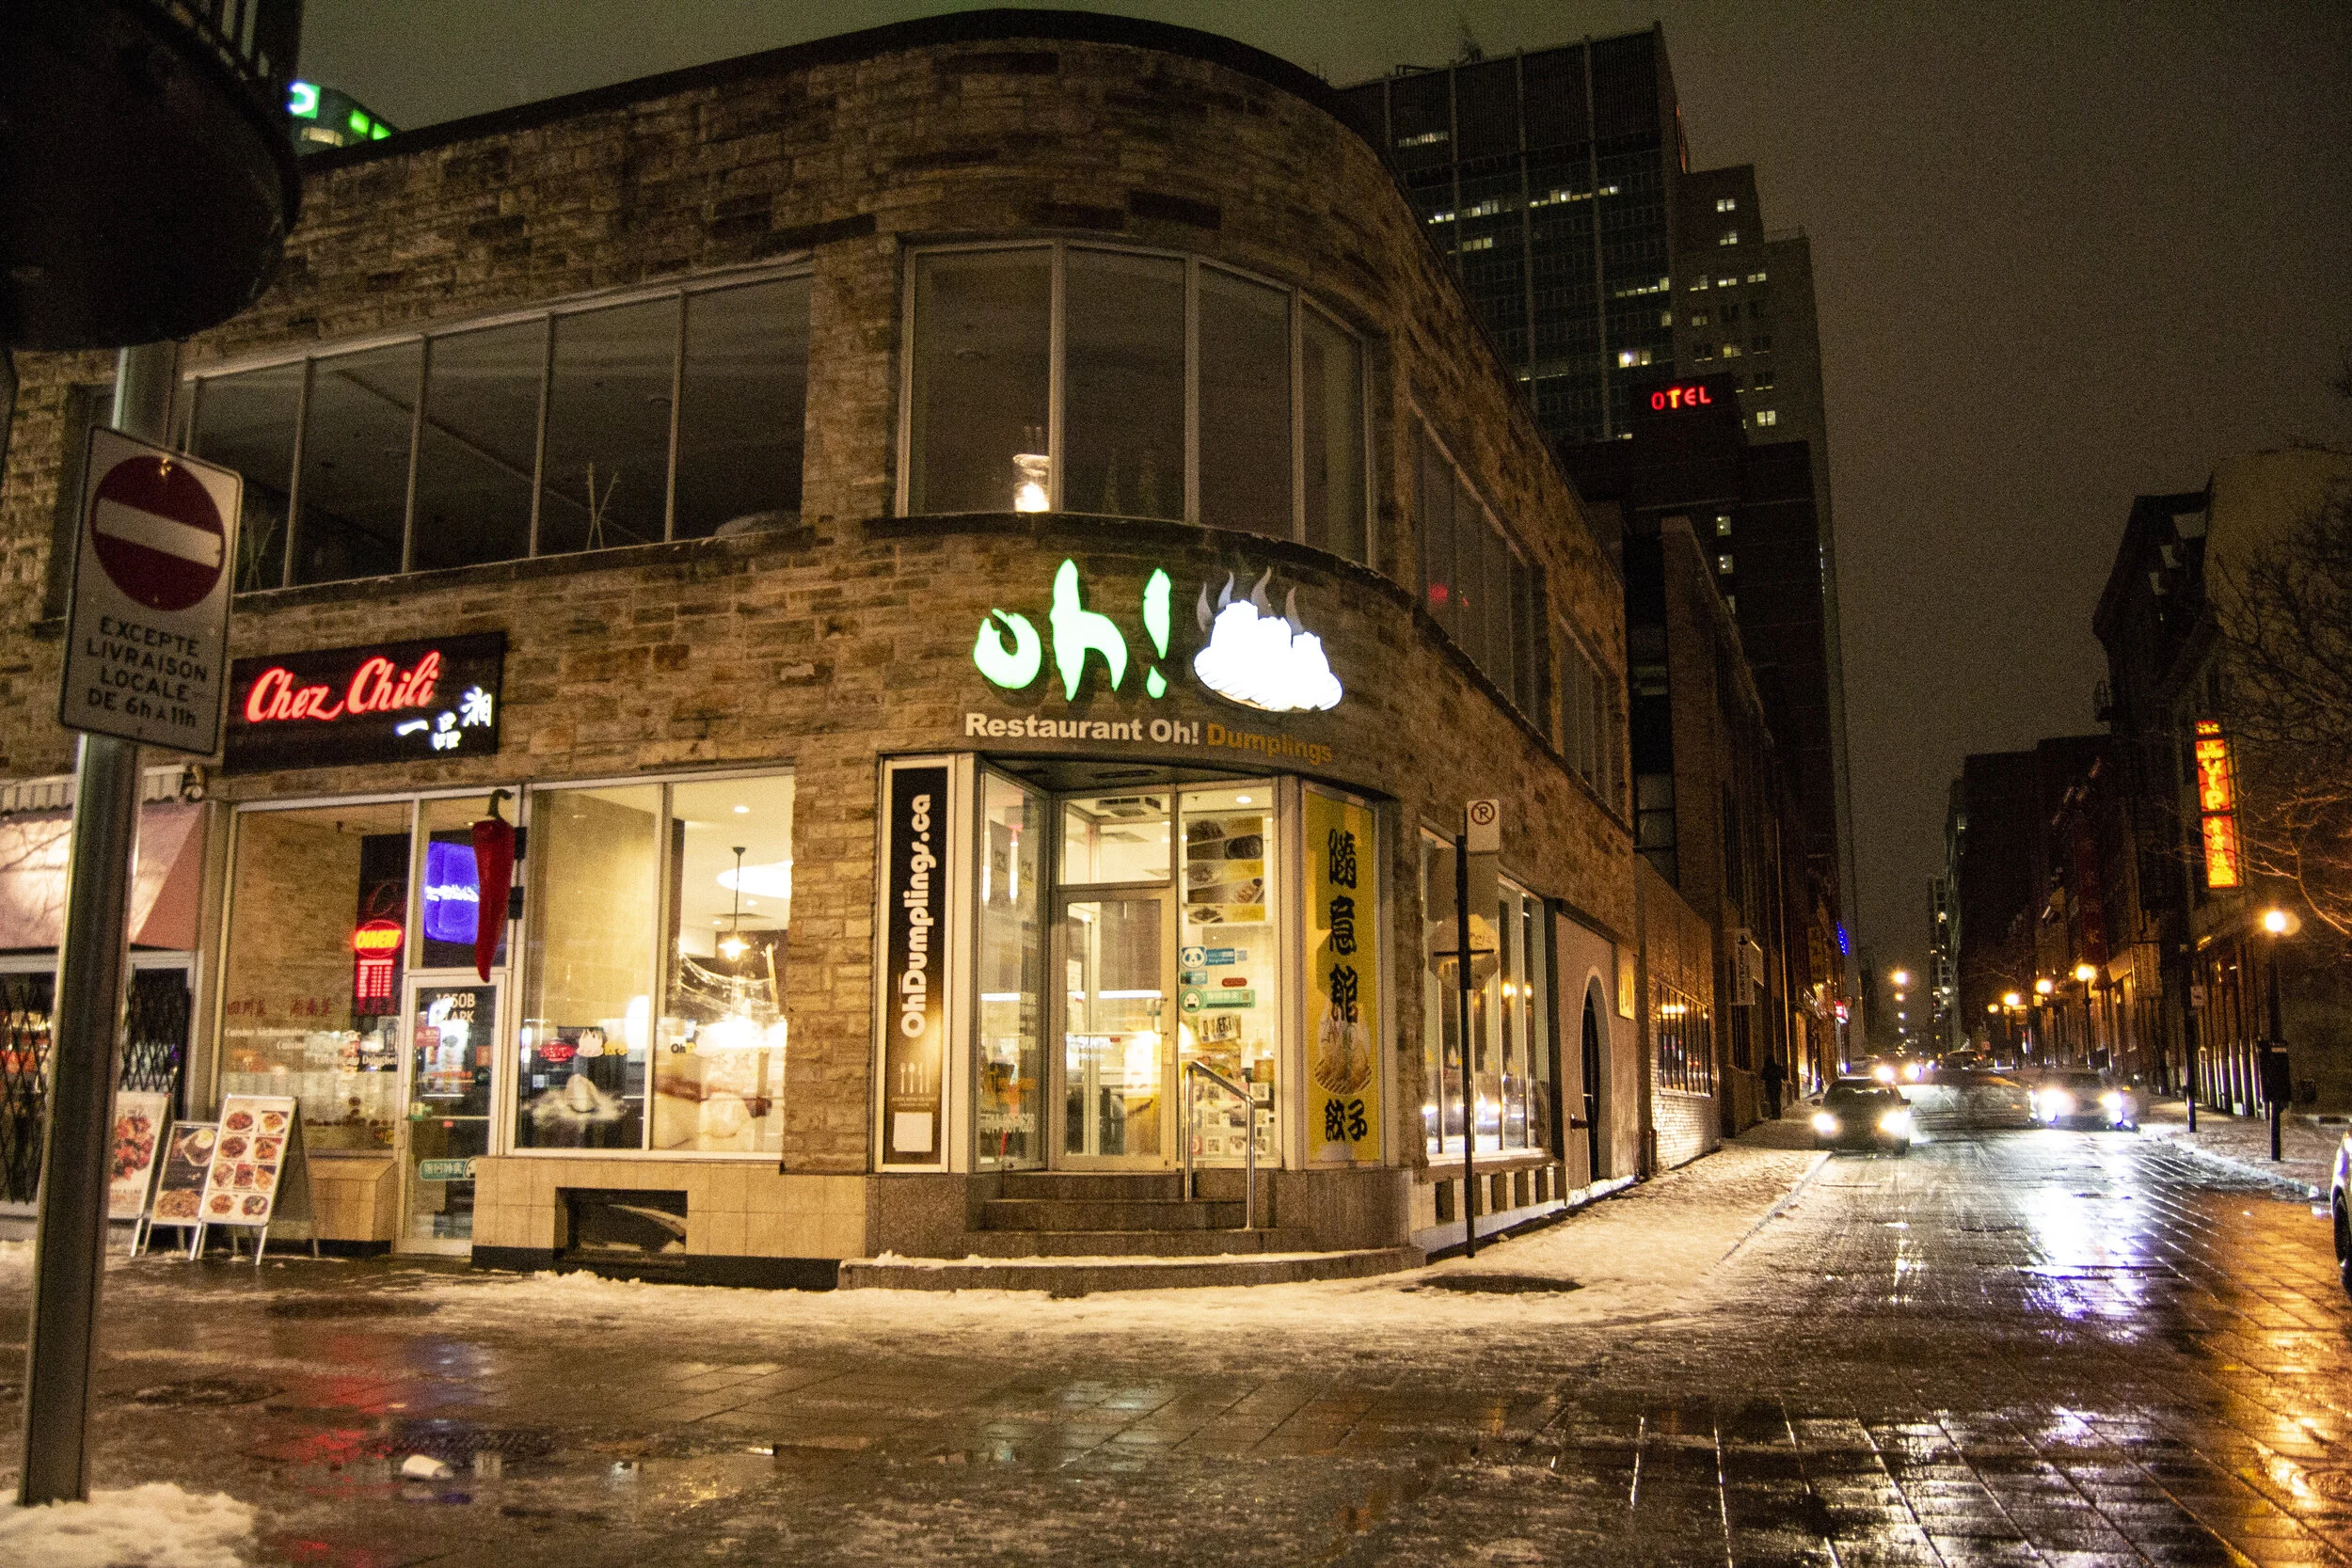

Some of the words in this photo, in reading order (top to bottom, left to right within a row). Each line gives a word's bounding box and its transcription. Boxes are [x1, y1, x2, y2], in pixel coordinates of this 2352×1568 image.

[87, 638, 208, 683] LIVRAISON
[100, 664, 190, 703] LOCALE
[87, 688, 117, 711] DE
[125, 696, 151, 720] 6h
[171, 706, 196, 728] 11h
[245, 666, 344, 723] Chez
[347, 650, 440, 715] Chili
[965, 712, 1143, 742] Restaurant
[1149, 720, 1200, 746] Oh!
[1206, 721, 1333, 766] Dumplings
[900, 793, 937, 1039] OhDumplings.ca
